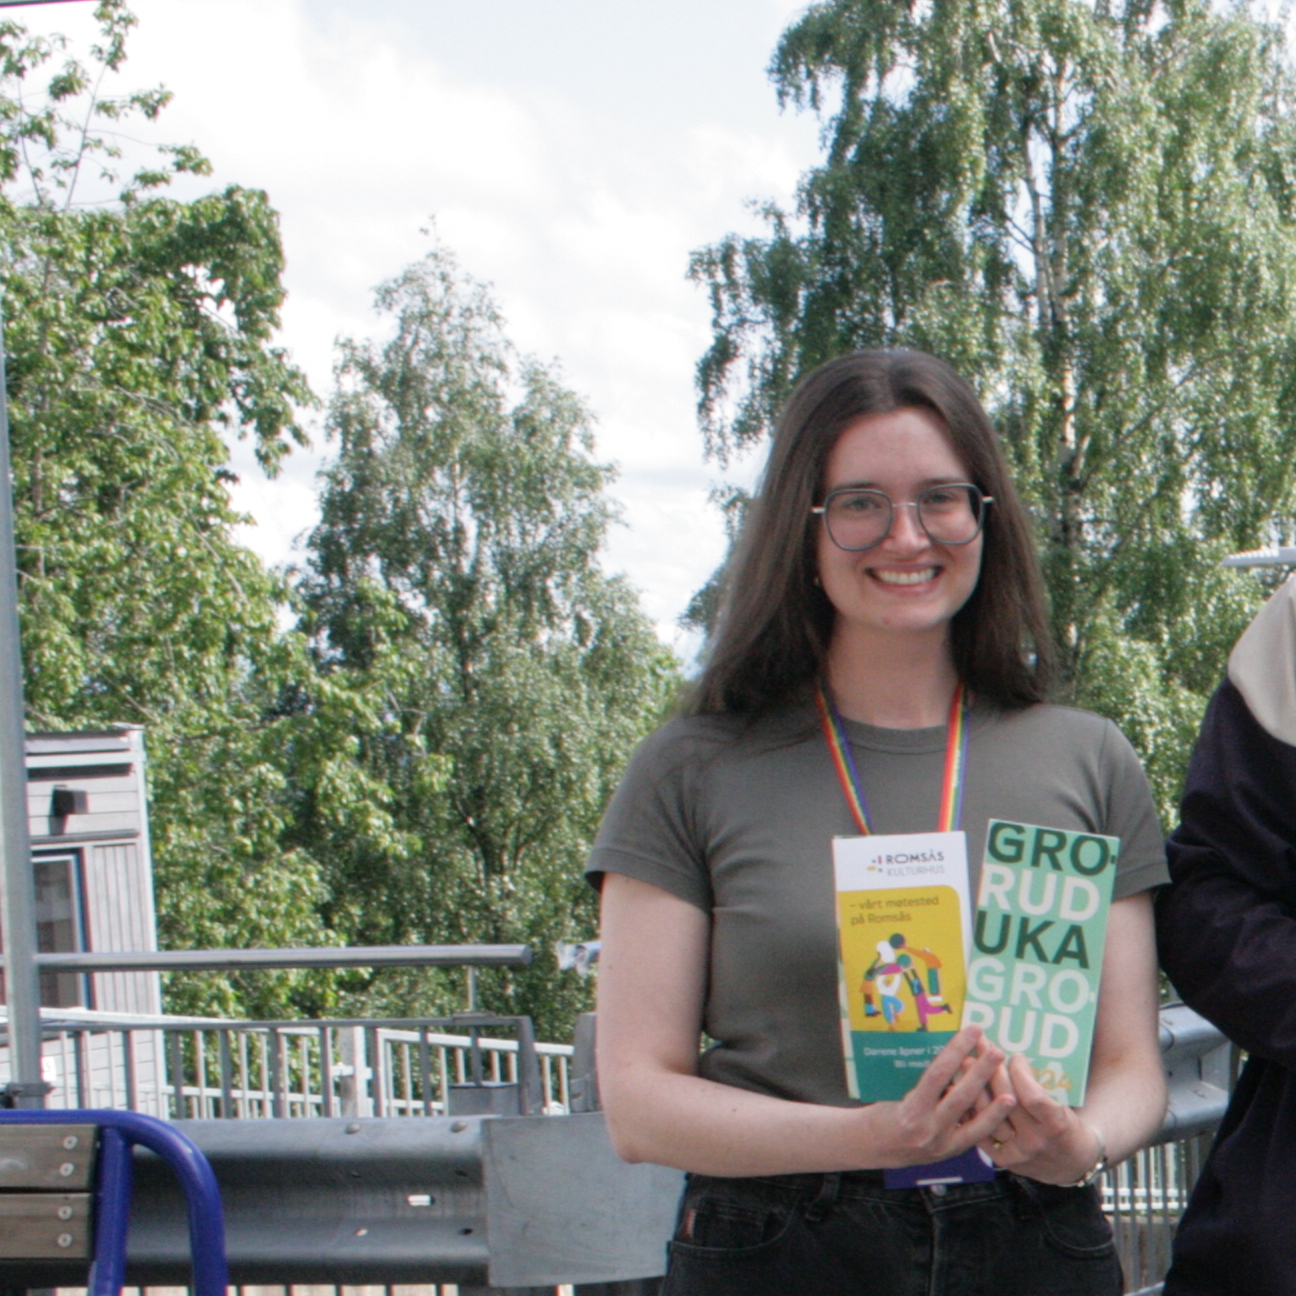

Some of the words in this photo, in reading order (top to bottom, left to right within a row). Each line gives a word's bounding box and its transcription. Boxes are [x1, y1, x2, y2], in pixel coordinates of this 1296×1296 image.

[886, 848, 944, 864] ROMSÅS
[978, 862, 1100, 922] RUD
[974, 910, 1090, 969] UKA
